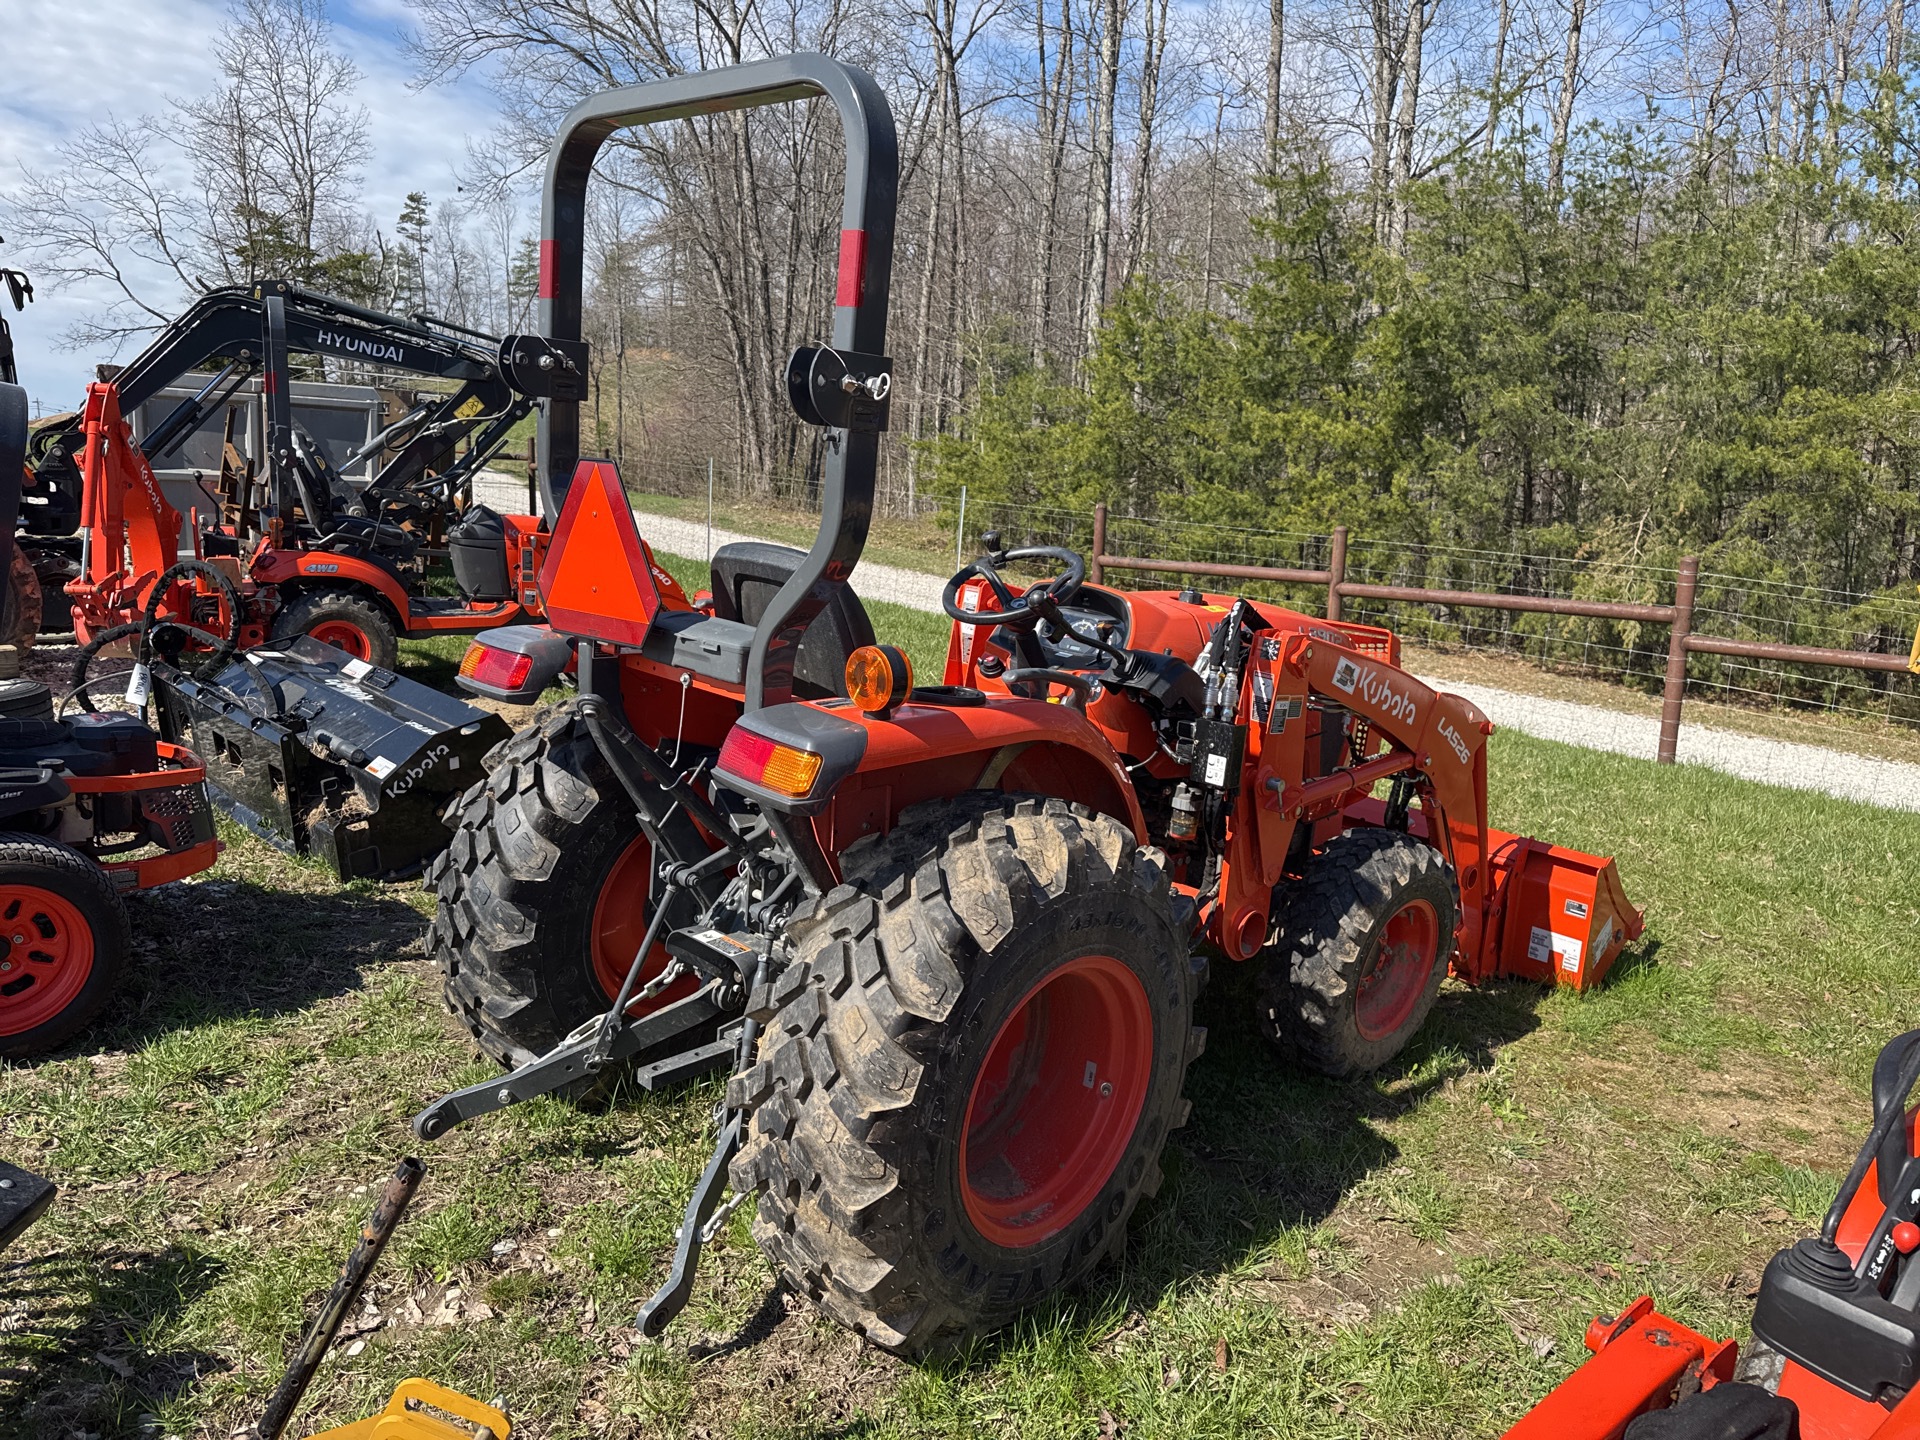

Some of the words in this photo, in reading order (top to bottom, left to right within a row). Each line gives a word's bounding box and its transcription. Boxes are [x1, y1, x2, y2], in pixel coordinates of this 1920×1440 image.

[317, 329, 404, 363] HYUNDAI
[140, 464, 162, 514] Kubota
[304, 563, 339, 573] 4WD
[1358, 666, 1416, 726] Kubota
[1437, 716, 1471, 765] LA526
[385, 744, 450, 799] Kubota
